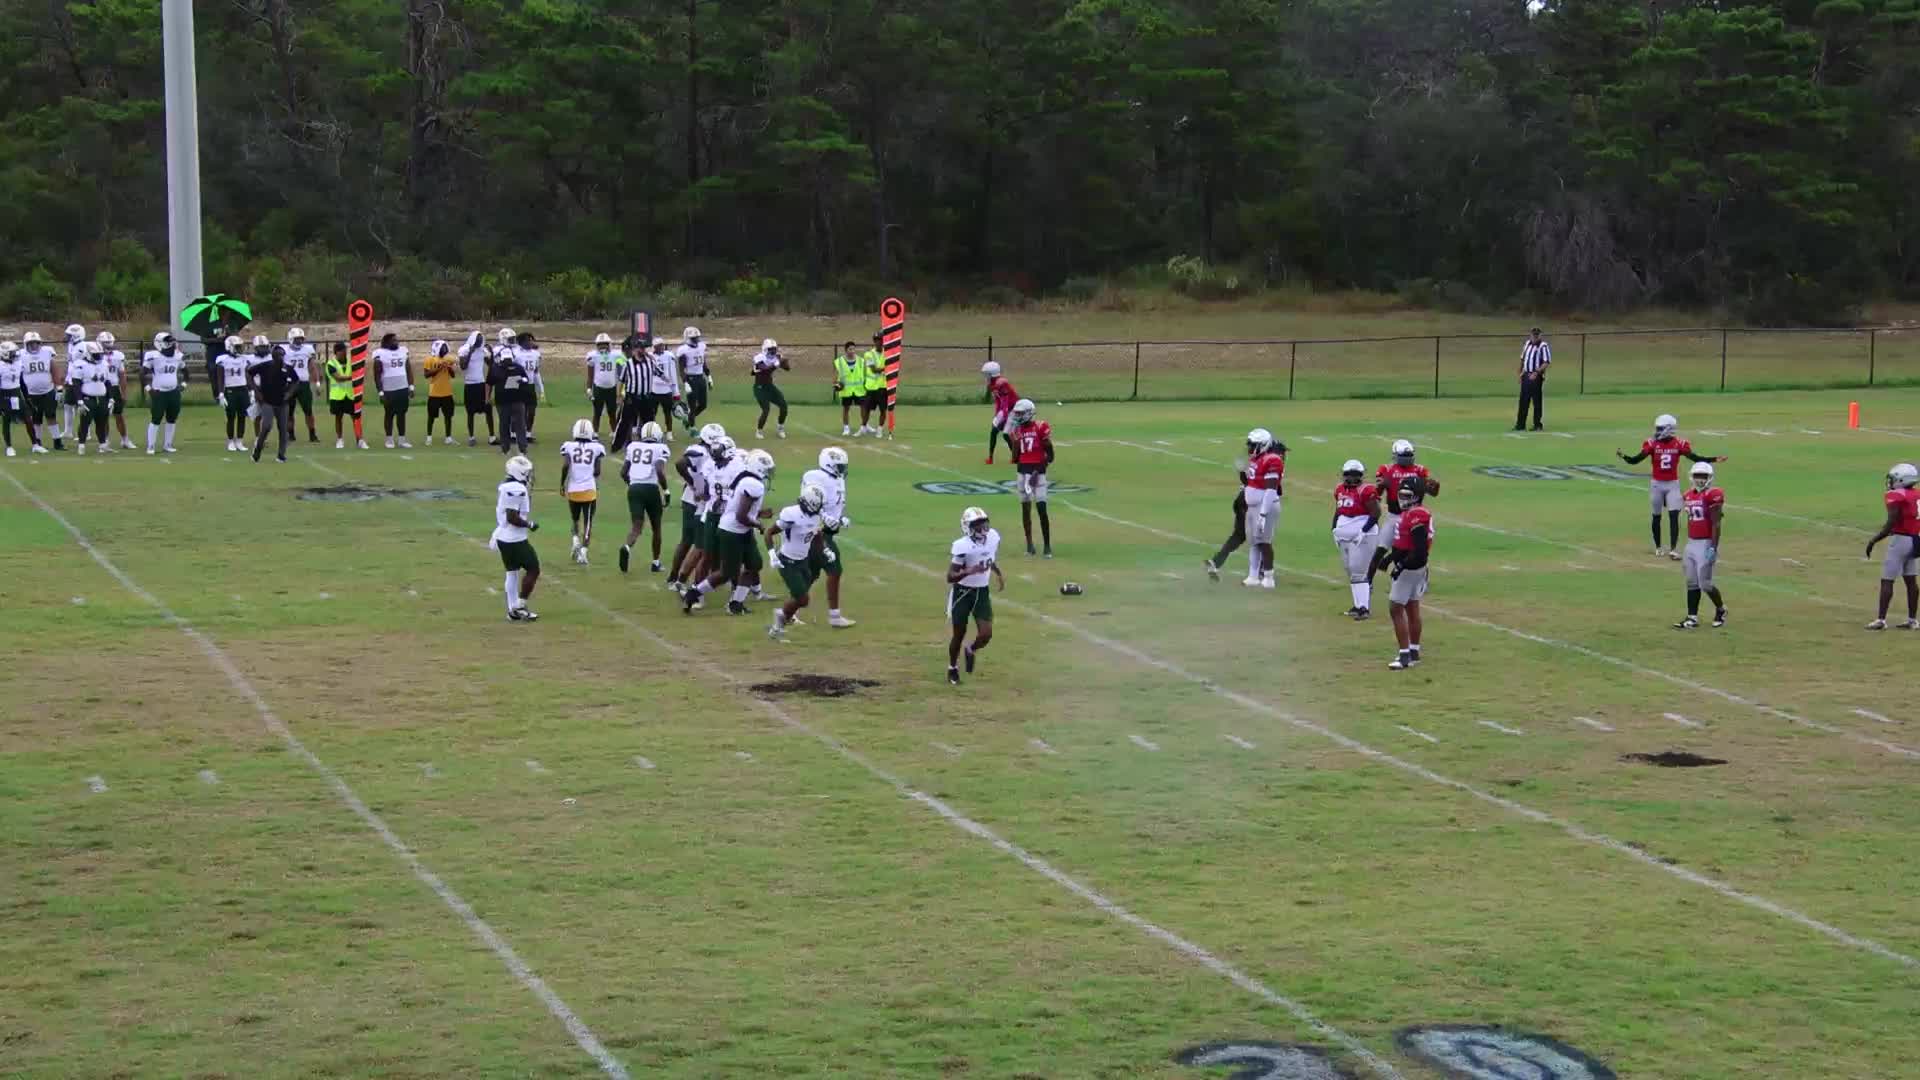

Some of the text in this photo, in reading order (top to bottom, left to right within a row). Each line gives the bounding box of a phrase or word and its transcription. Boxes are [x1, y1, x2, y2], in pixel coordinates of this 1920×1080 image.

[1020, 437, 1034, 454] 17
[573, 448, 594, 464] 23
[632, 448, 654, 465] 83
[1660, 454, 1672, 469] 2
